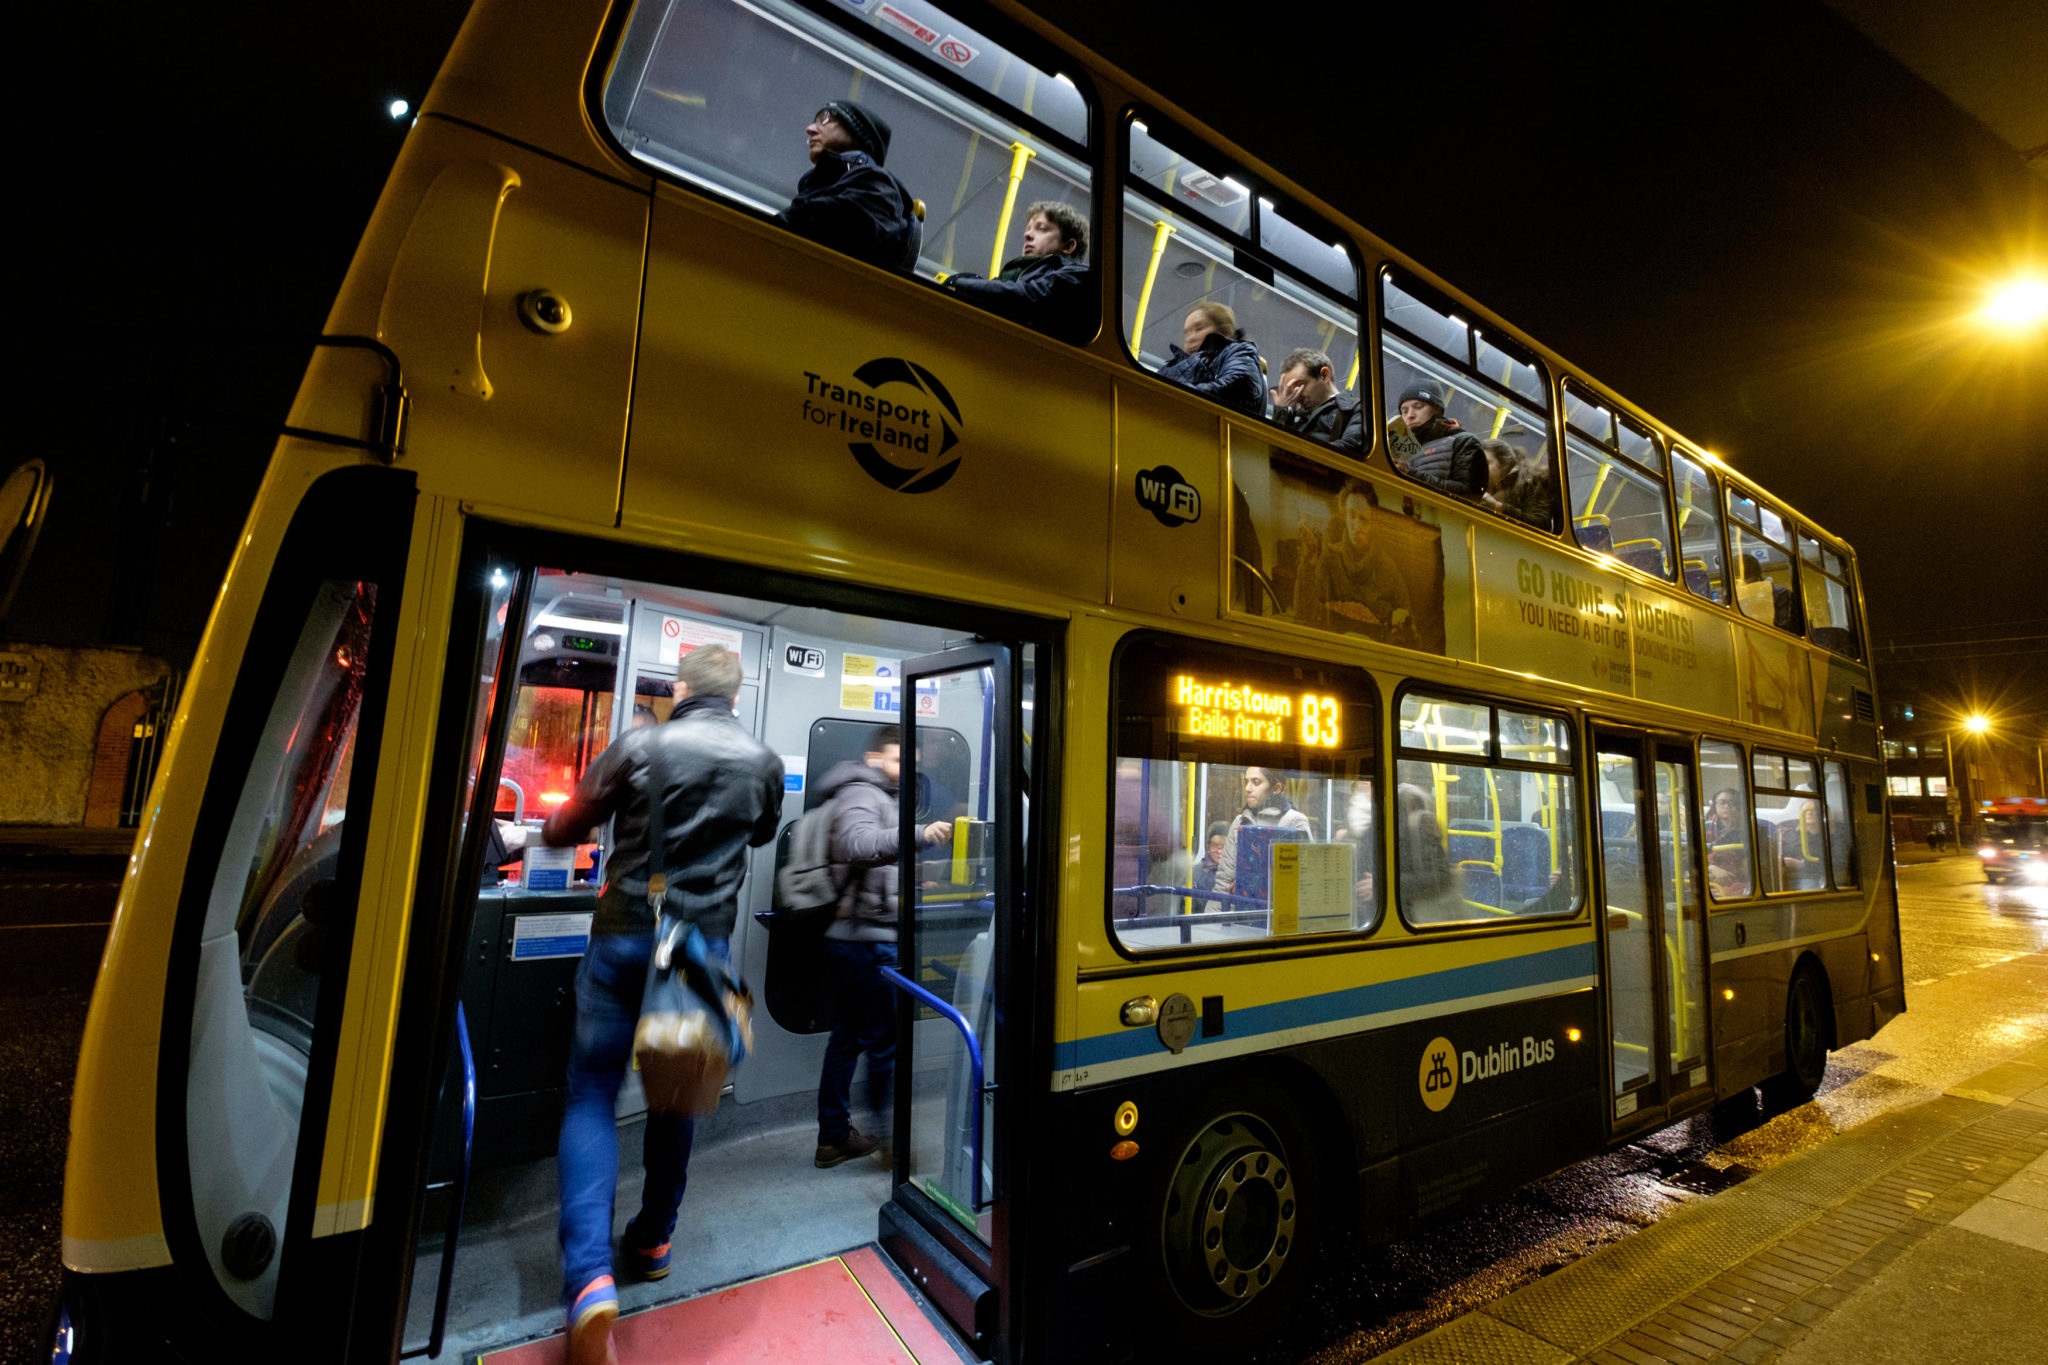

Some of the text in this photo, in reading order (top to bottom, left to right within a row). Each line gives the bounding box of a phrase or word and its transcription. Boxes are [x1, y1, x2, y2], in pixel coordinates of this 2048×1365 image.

[802, 400, 929, 453] for Ireland
[803, 371, 931, 428] Transport
[1517, 558, 1545, 598] GO
[1550, 569, 1610, 624] HOME,
[1518, 600, 1697, 670] YOU NEED A BIT OF OOKING AFTER
[1177, 675, 1292, 717] Harristown
[1190, 706, 1230, 738] Baile
[1301, 693, 1339, 748] 83
[1462, 1036, 1555, 1084] Dublin Bus
